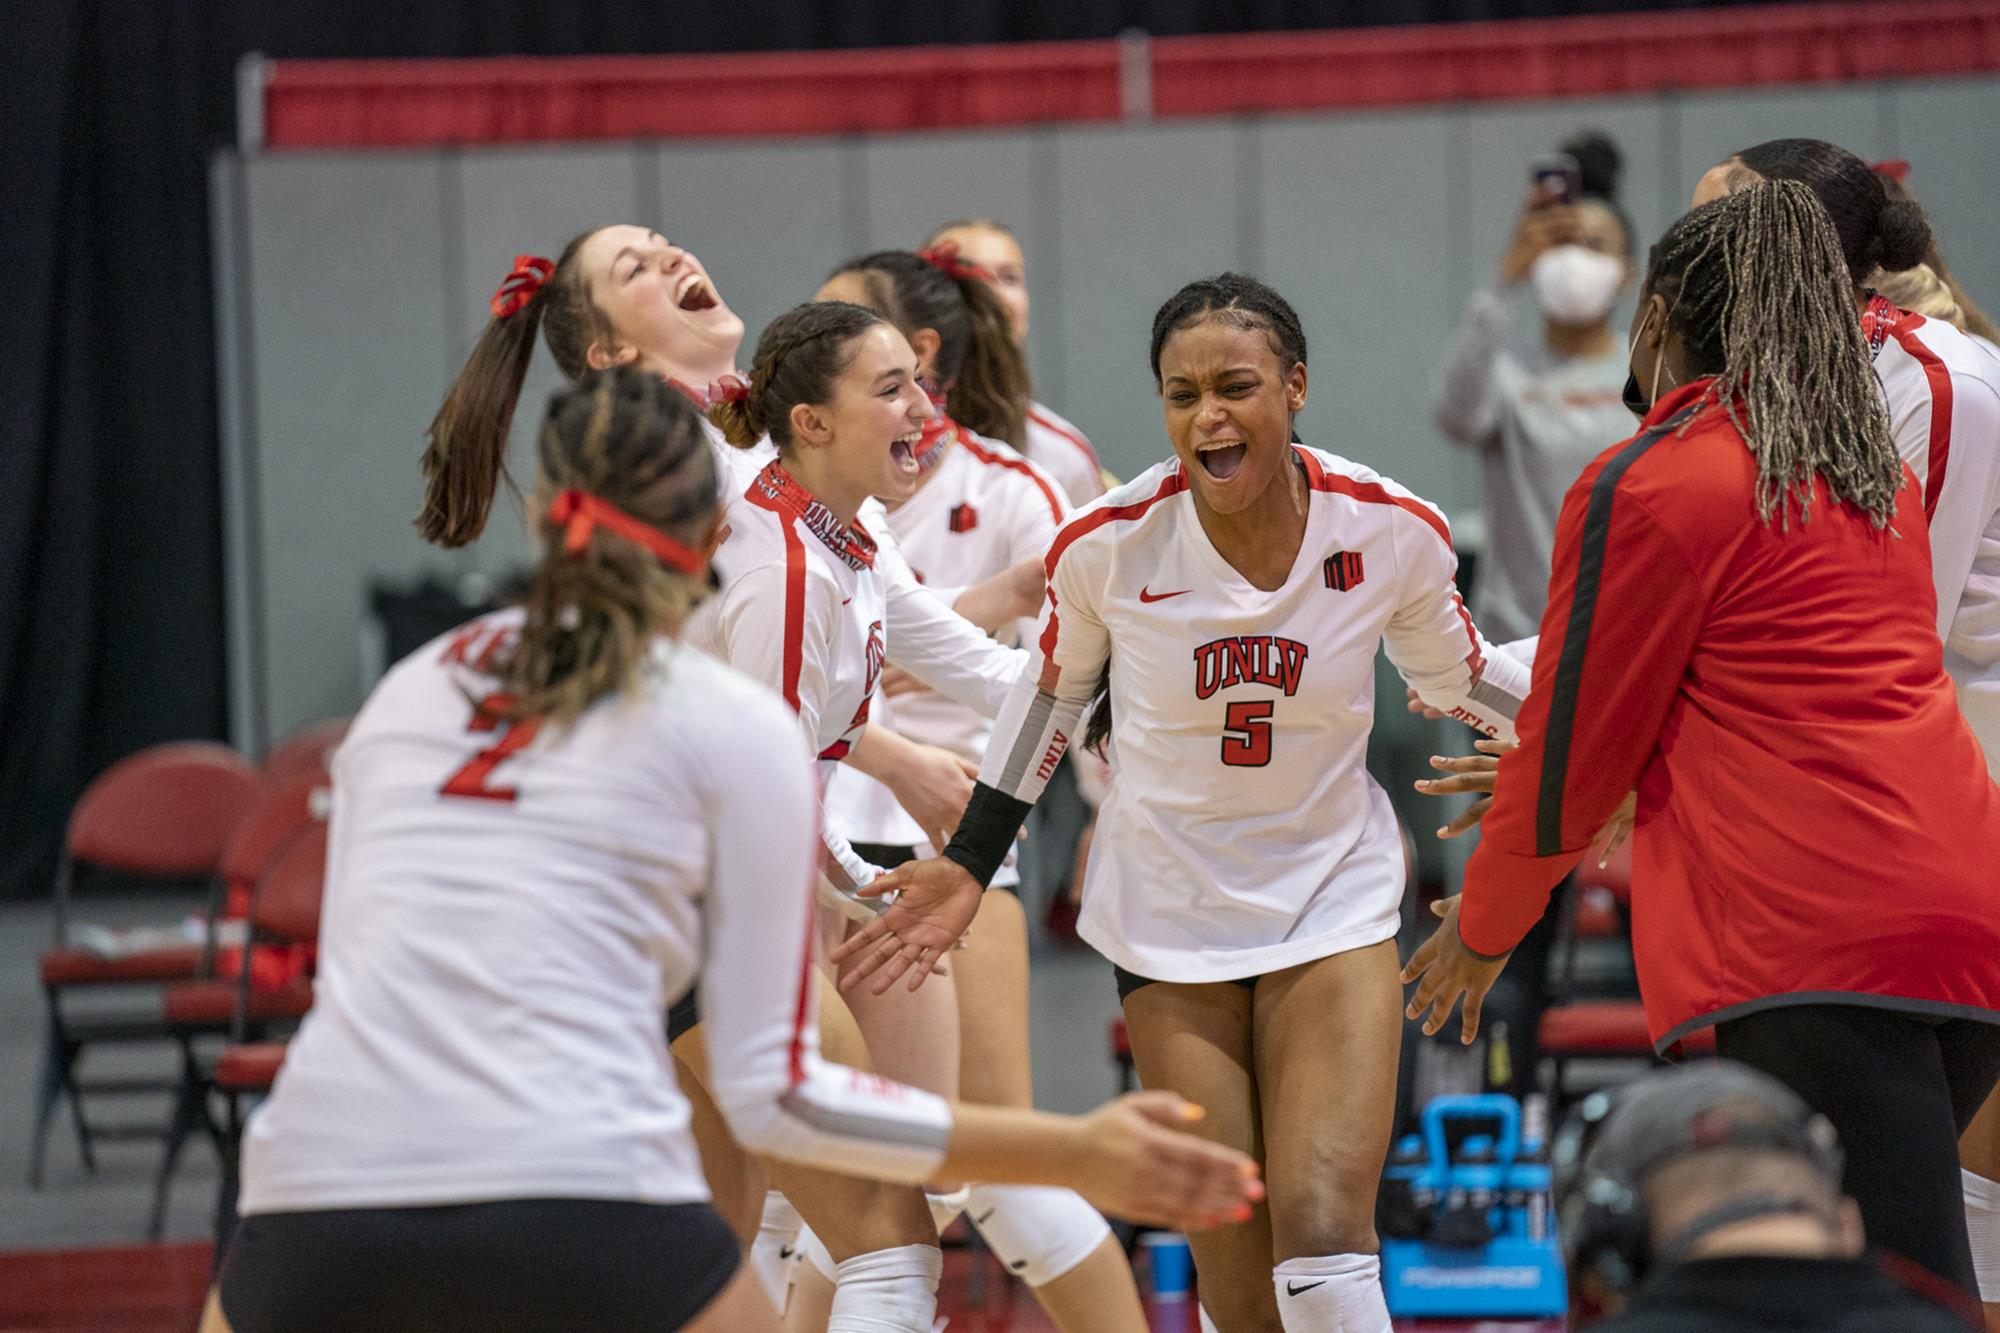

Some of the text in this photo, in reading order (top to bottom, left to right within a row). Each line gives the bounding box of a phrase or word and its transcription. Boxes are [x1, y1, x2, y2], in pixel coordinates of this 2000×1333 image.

[1193, 636, 1309, 700] UNLV
[1036, 728, 1069, 781] UNLV
[1221, 700, 1274, 767] 5
